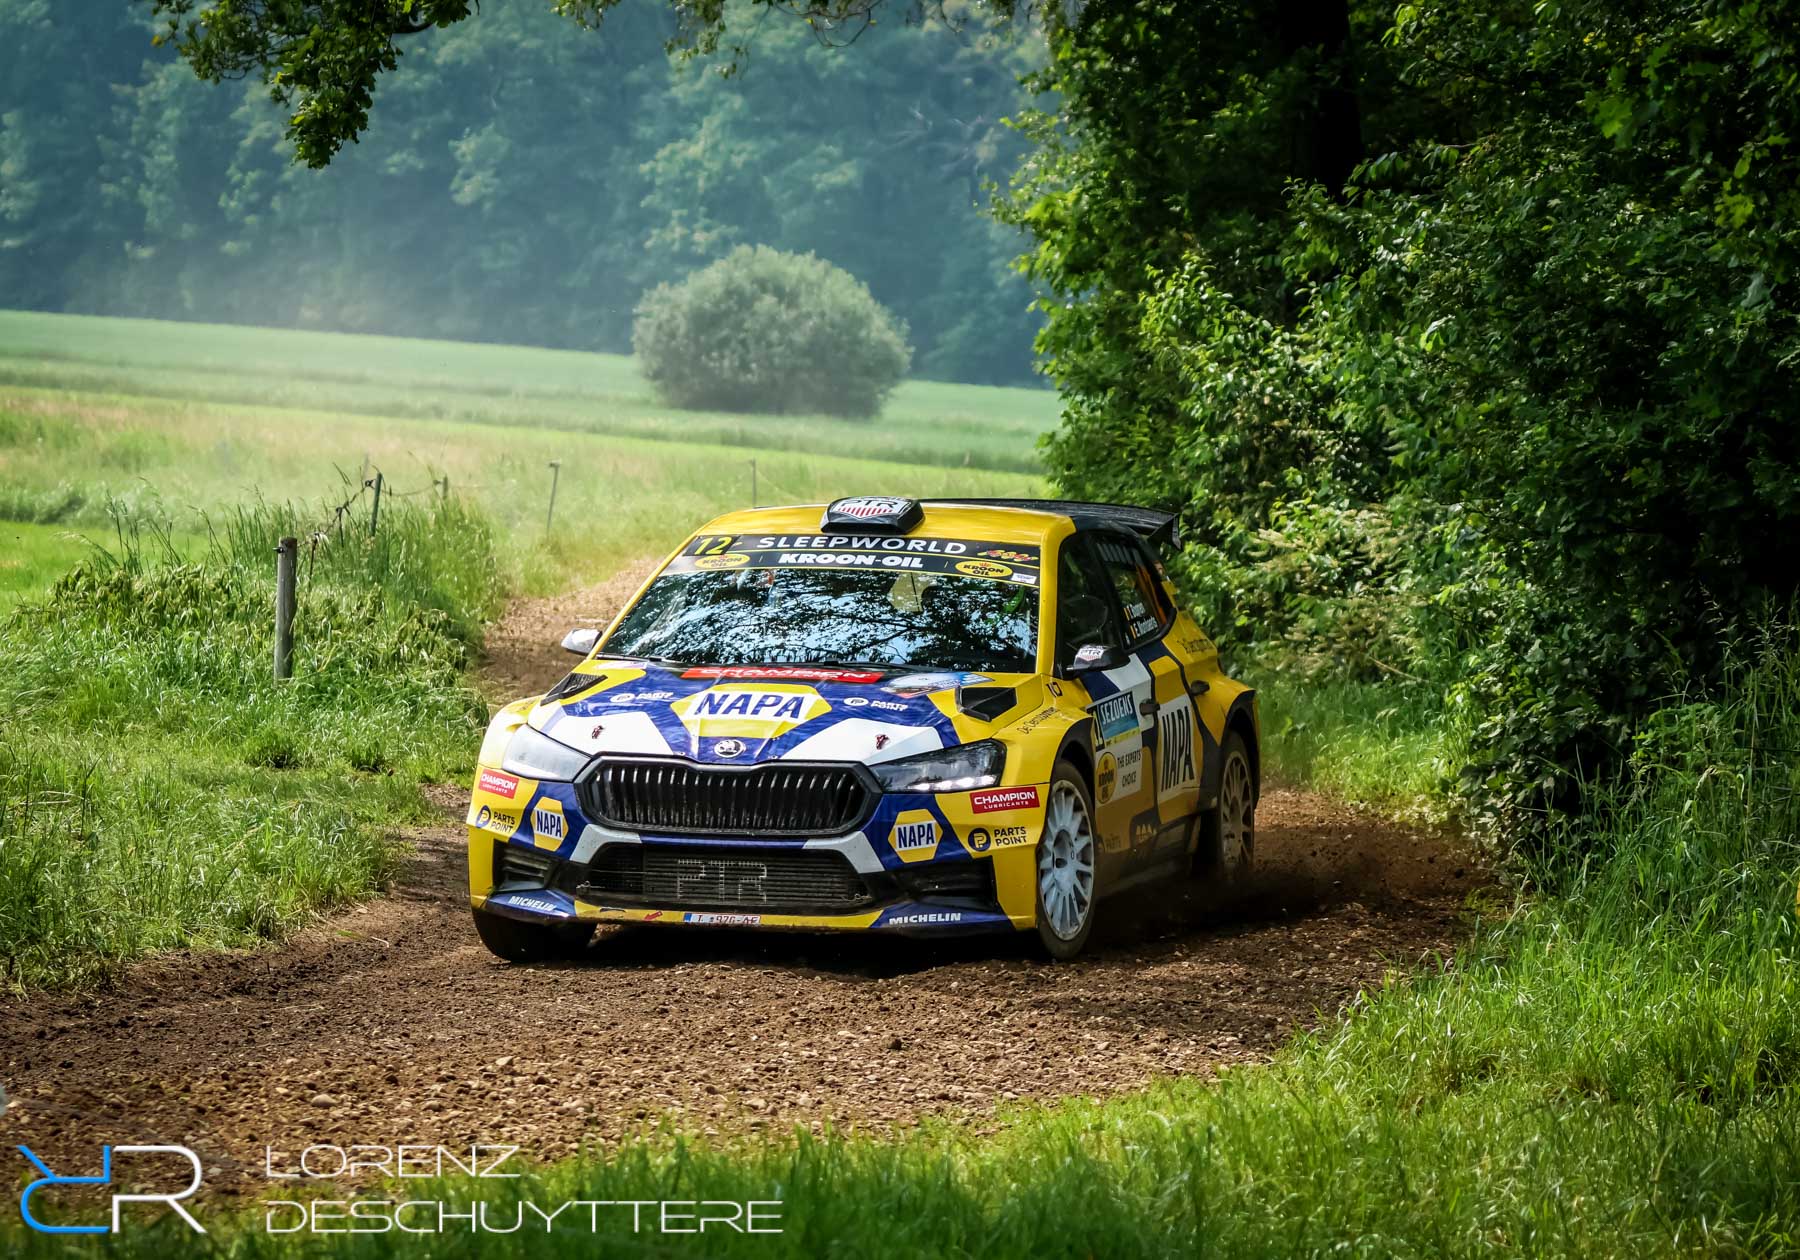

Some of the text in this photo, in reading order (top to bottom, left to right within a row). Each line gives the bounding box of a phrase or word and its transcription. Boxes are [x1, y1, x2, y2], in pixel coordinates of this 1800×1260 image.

[694, 536, 733, 555] 12
[757, 536, 967, 554] SLEEPWORLD
[778, 553, 924, 568] KROON-OIL
[963, 563, 1005, 574] KROON
[694, 692, 805, 719] NAPA
[1100, 692, 1134, 725] SEZOENS
[1125, 750, 1142, 765] EXPERTS
[1161, 706, 1195, 793] NAPA
[480, 773, 517, 791] CHAMPION
[1121, 771, 1137, 788] CHOICE
[974, 791, 1035, 806] CHAMPION
[984, 801, 1029, 810] LUBRICANTS
[493, 811, 516, 825] PARTS
[536, 810, 563, 838] NAPA
[490, 821, 514, 833] POINT
[994, 826, 1026, 837] PARTS
[897, 823, 935, 848] NAPA
[996, 835, 1027, 847] POINT
[677, 859, 767, 903] PTR
[508, 895, 557, 911] MICHELIN
[889, 912, 961, 925] MICHELIN
